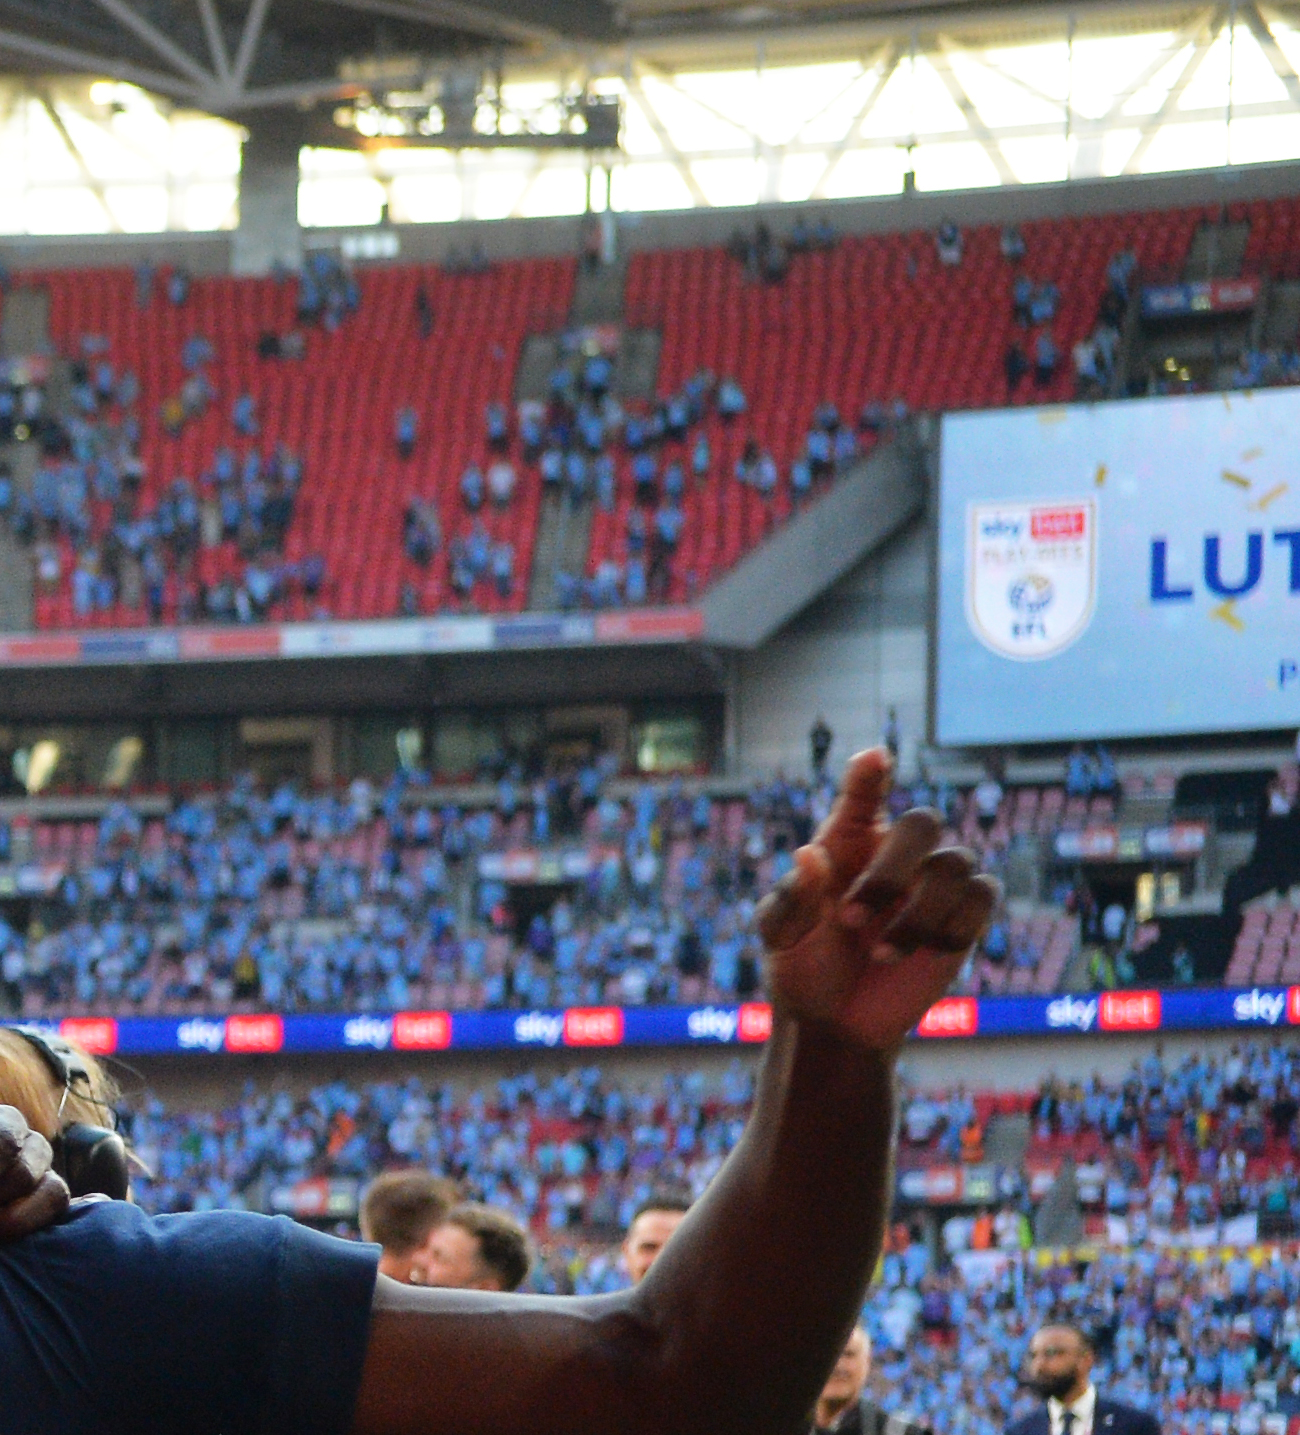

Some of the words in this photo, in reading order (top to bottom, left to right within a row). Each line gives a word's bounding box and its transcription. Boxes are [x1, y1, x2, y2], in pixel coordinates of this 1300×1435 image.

[687, 1005, 737, 1043] sky
[1046, 994, 1097, 1032] sky
[1234, 988, 1285, 1024] sky
[177, 1016, 224, 1053] sky
[344, 1015, 392, 1050] sky
[514, 1010, 563, 1047] sky
